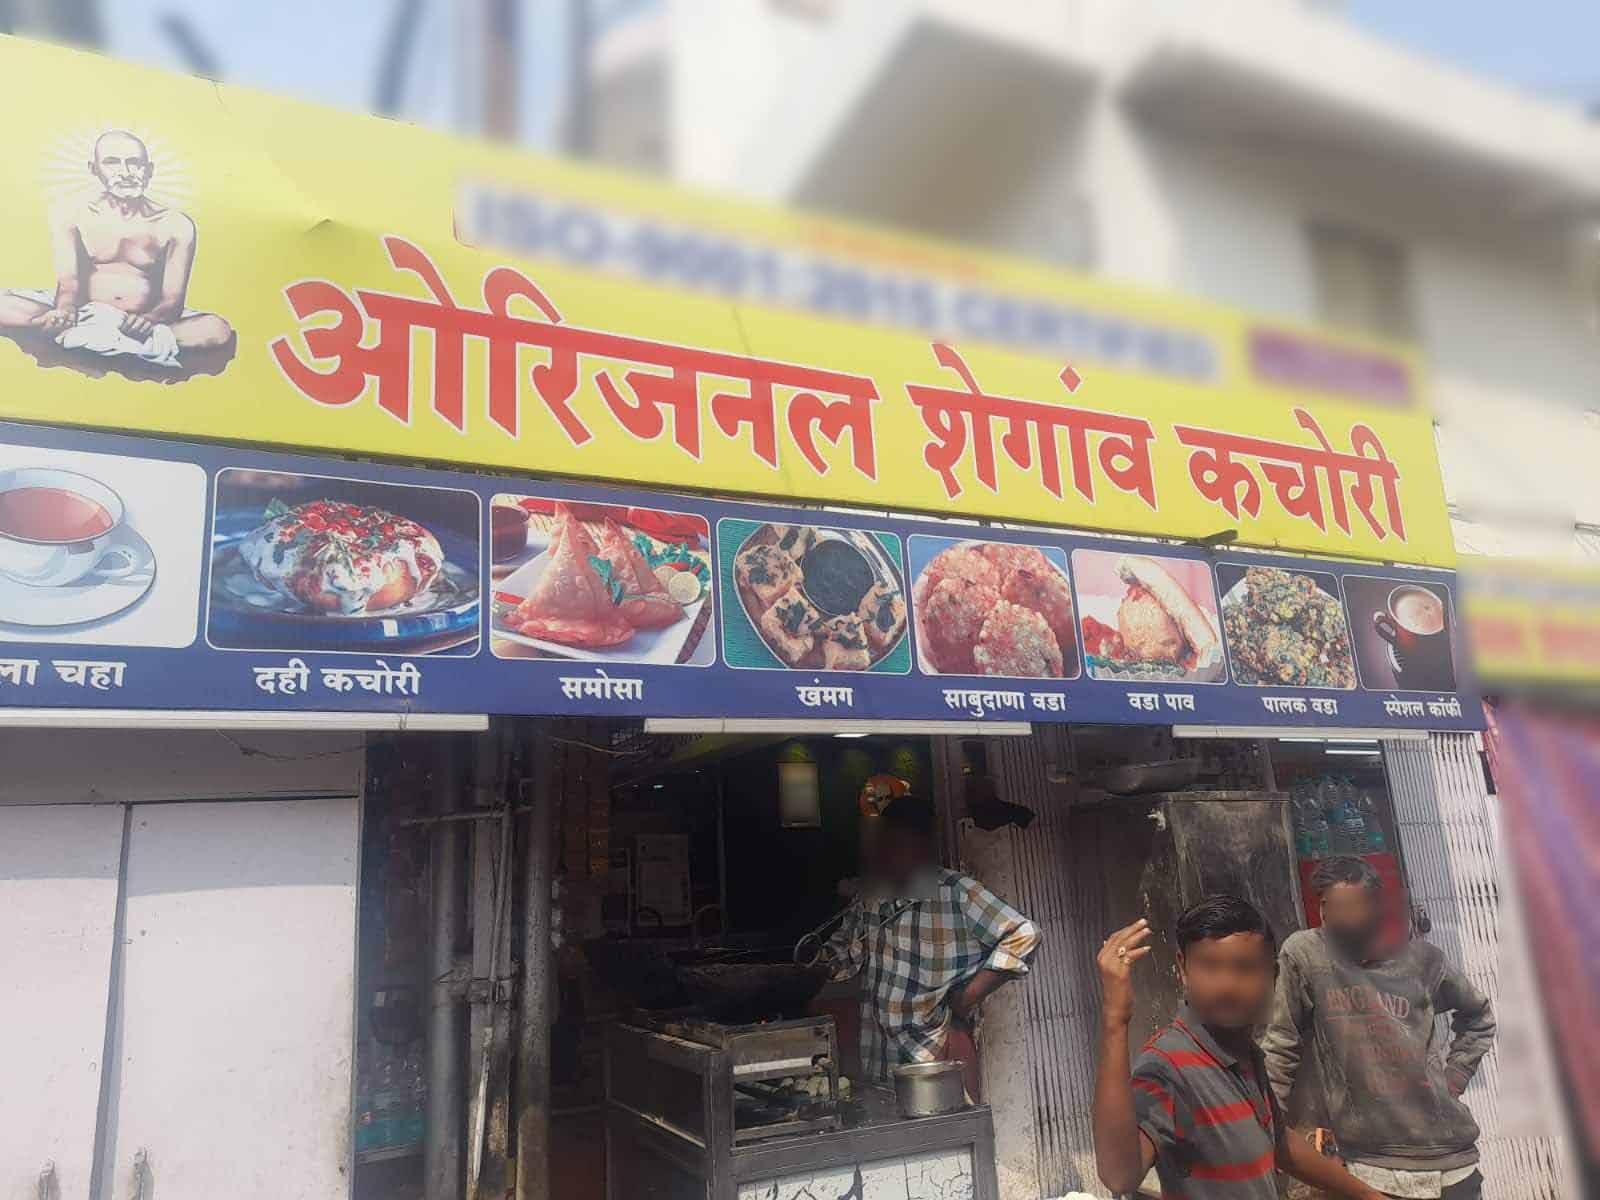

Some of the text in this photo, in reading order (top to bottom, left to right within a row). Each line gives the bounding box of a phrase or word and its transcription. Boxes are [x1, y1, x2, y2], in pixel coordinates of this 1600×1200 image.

[270, 235, 880, 481] ओरिजनल
[905, 342, 1158, 511] शेगांव
[1174, 407, 1407, 543] कचोरी
[51, 659, 127, 690] चहा
[252, 658, 421, 695] दही कचोरी
[559, 668, 644, 700] समोसा
[795, 677, 854, 707] खंमग
[942, 689, 1066, 717] साबुदाणा वडा
[1126, 692, 1195, 711] वडा पाव
[1261, 696, 1339, 715] पालक वडा
[1384, 694, 1463, 718] स्पेशल कॉफी
